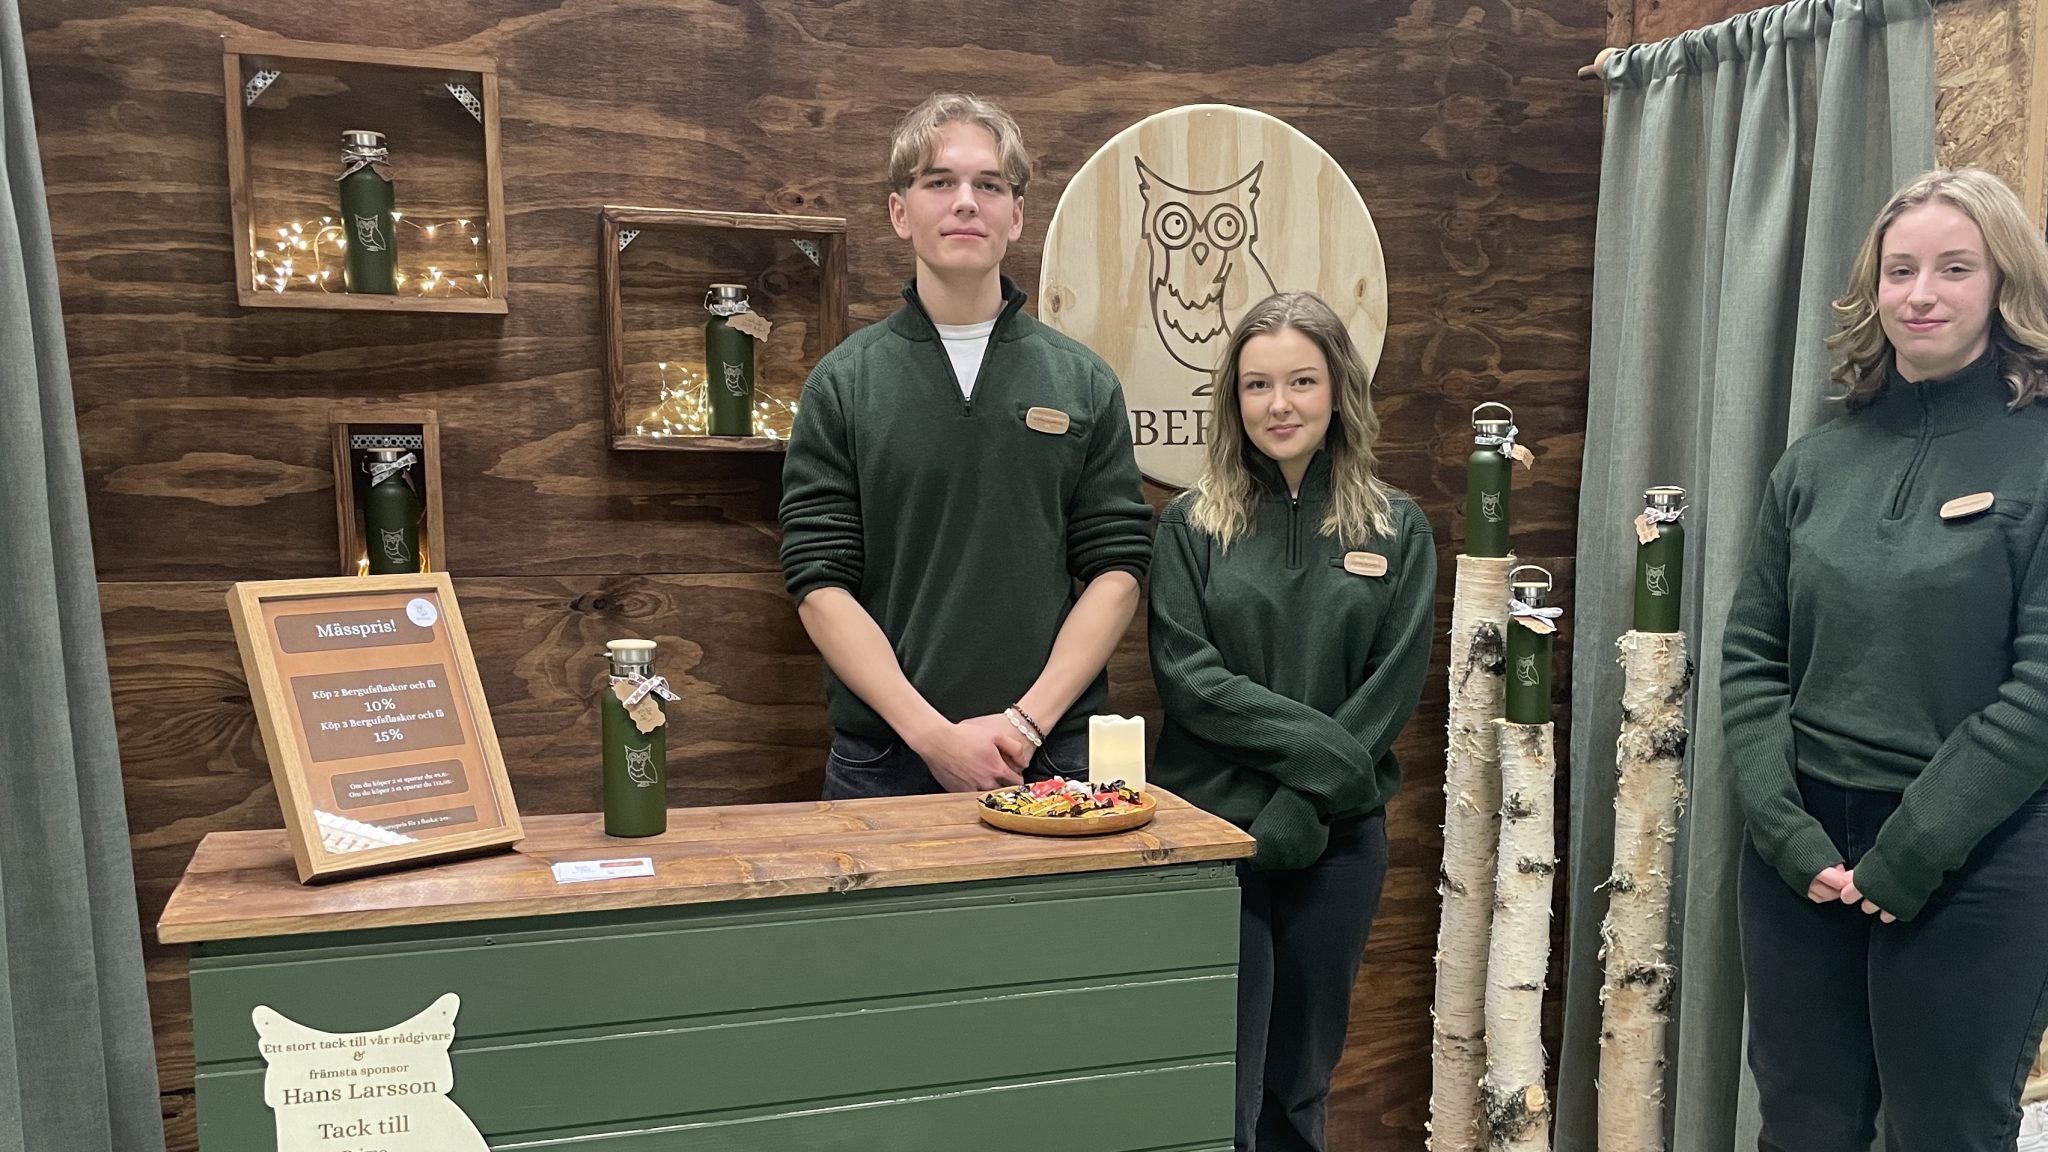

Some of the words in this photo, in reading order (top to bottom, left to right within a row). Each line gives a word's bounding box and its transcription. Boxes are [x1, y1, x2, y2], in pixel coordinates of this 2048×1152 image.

[315, 619, 397, 638] Mässpris!
[311, 690, 333, 700] Köp
[340, 684, 408, 697] Bergufsflaskor
[409, 681, 426, 690] och
[427, 679, 437, 688] få
[363, 697, 396, 712] 10%
[320, 721, 341, 731] Köp
[342, 721, 348, 729] 3
[350, 714, 416, 727] Bergufsflaskor
[418, 710, 434, 719] och
[435, 709, 445, 718] få
[373, 728, 404, 743] 15%
[264, 1044, 283, 1053] Ett
[286, 1042, 316, 1052] stort
[320, 1038, 347, 1049] tack
[350, 1036, 367, 1047] till
[369, 1035, 390, 1045] vår
[393, 1032, 451, 1044] rådgivare
[353, 1050, 366, 1062] &
[309, 1069, 358, 1080] främsta
[360, 1065, 410, 1077] sponsor
[283, 1088, 342, 1105] Hans
[348, 1081, 437, 1099] Larsson
[318, 1118, 372, 1140] Tack
[378, 1115, 410, 1135] till
